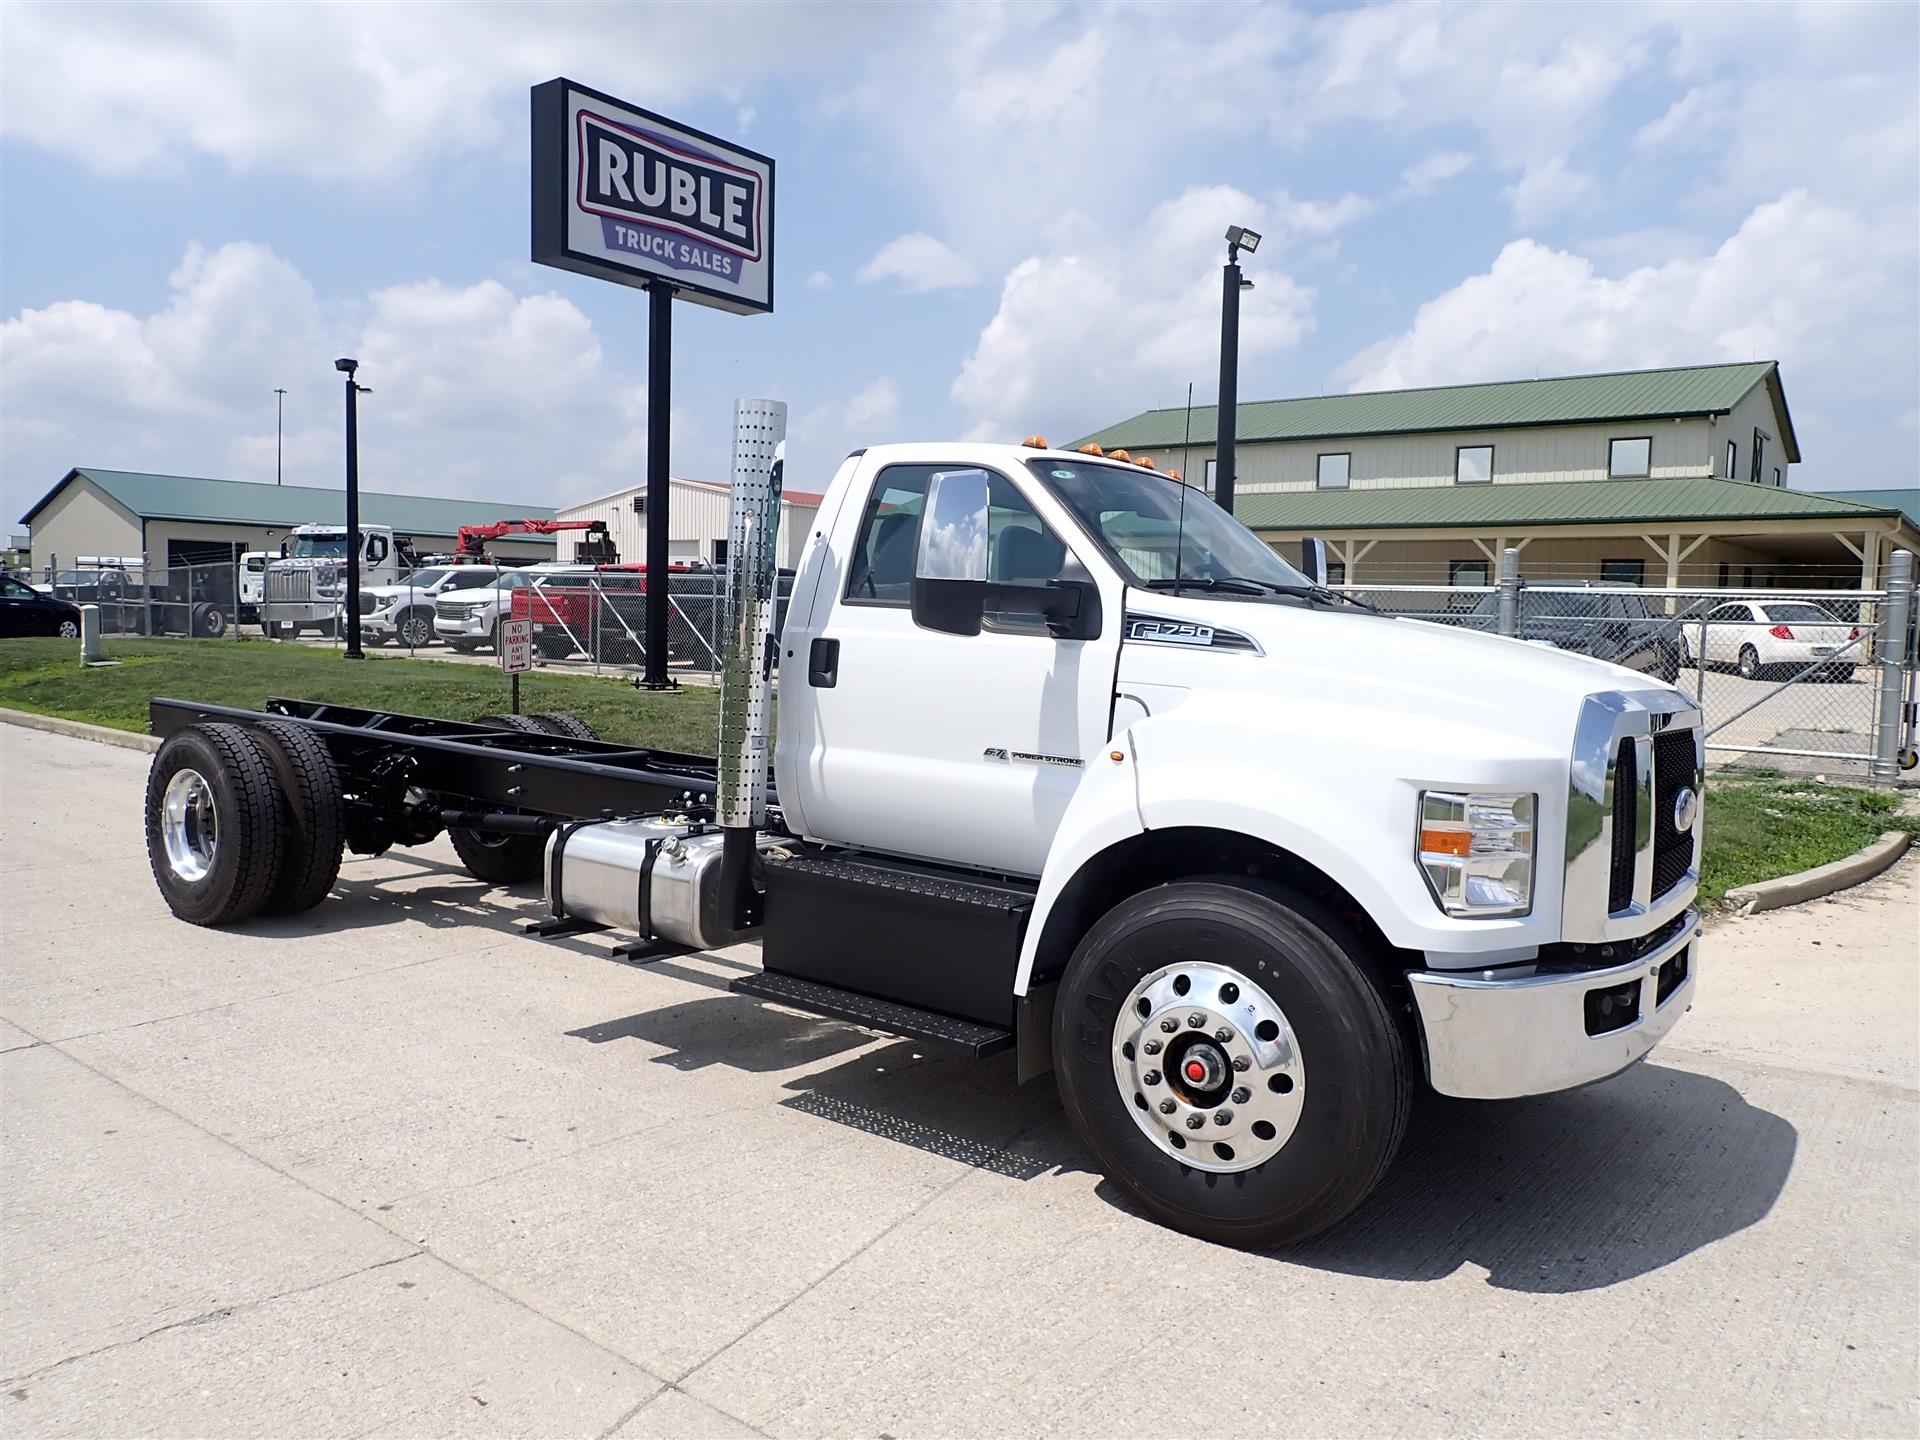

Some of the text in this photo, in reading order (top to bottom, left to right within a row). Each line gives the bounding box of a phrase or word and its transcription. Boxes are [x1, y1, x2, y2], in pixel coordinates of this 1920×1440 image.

[599, 138, 747, 238] RUBLE
[615, 225, 732, 275] TRUCK SALES
[511, 623, 522, 634] NO
[505, 634, 528, 645] PARKING
[1012, 752, 1044, 761] POWER
[1044, 756, 1082, 765] STROKE
